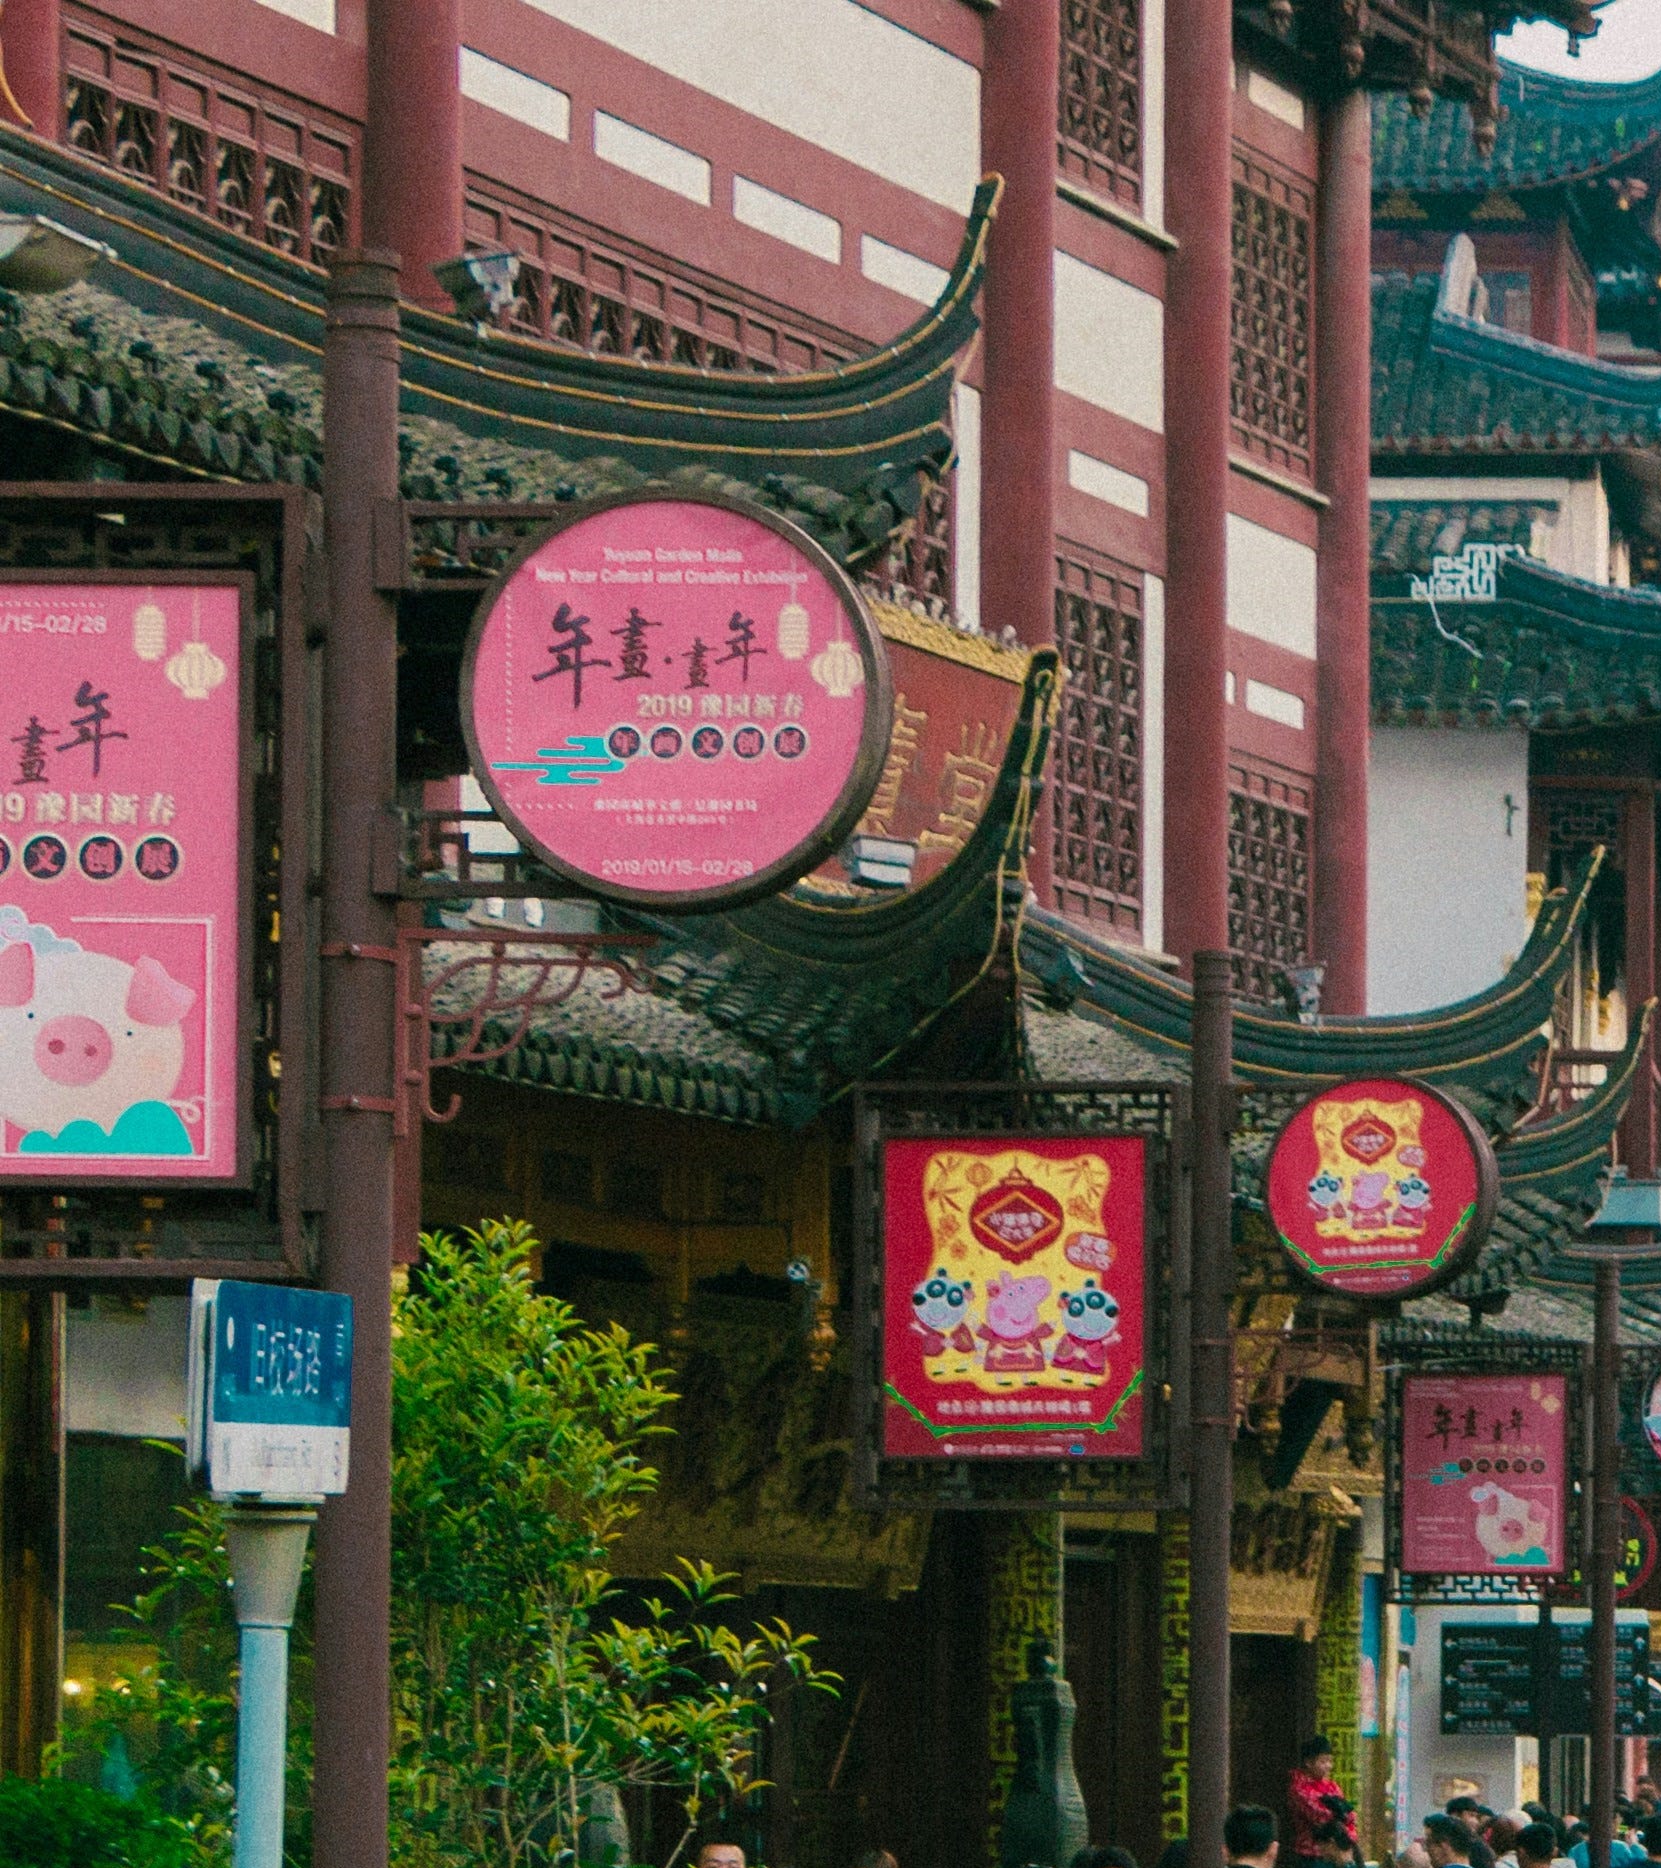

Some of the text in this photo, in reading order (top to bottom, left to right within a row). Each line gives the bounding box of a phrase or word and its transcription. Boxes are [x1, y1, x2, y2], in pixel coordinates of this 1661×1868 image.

[636, 695, 693, 718] 2019
[0, 836, 181, 880] 文创展
